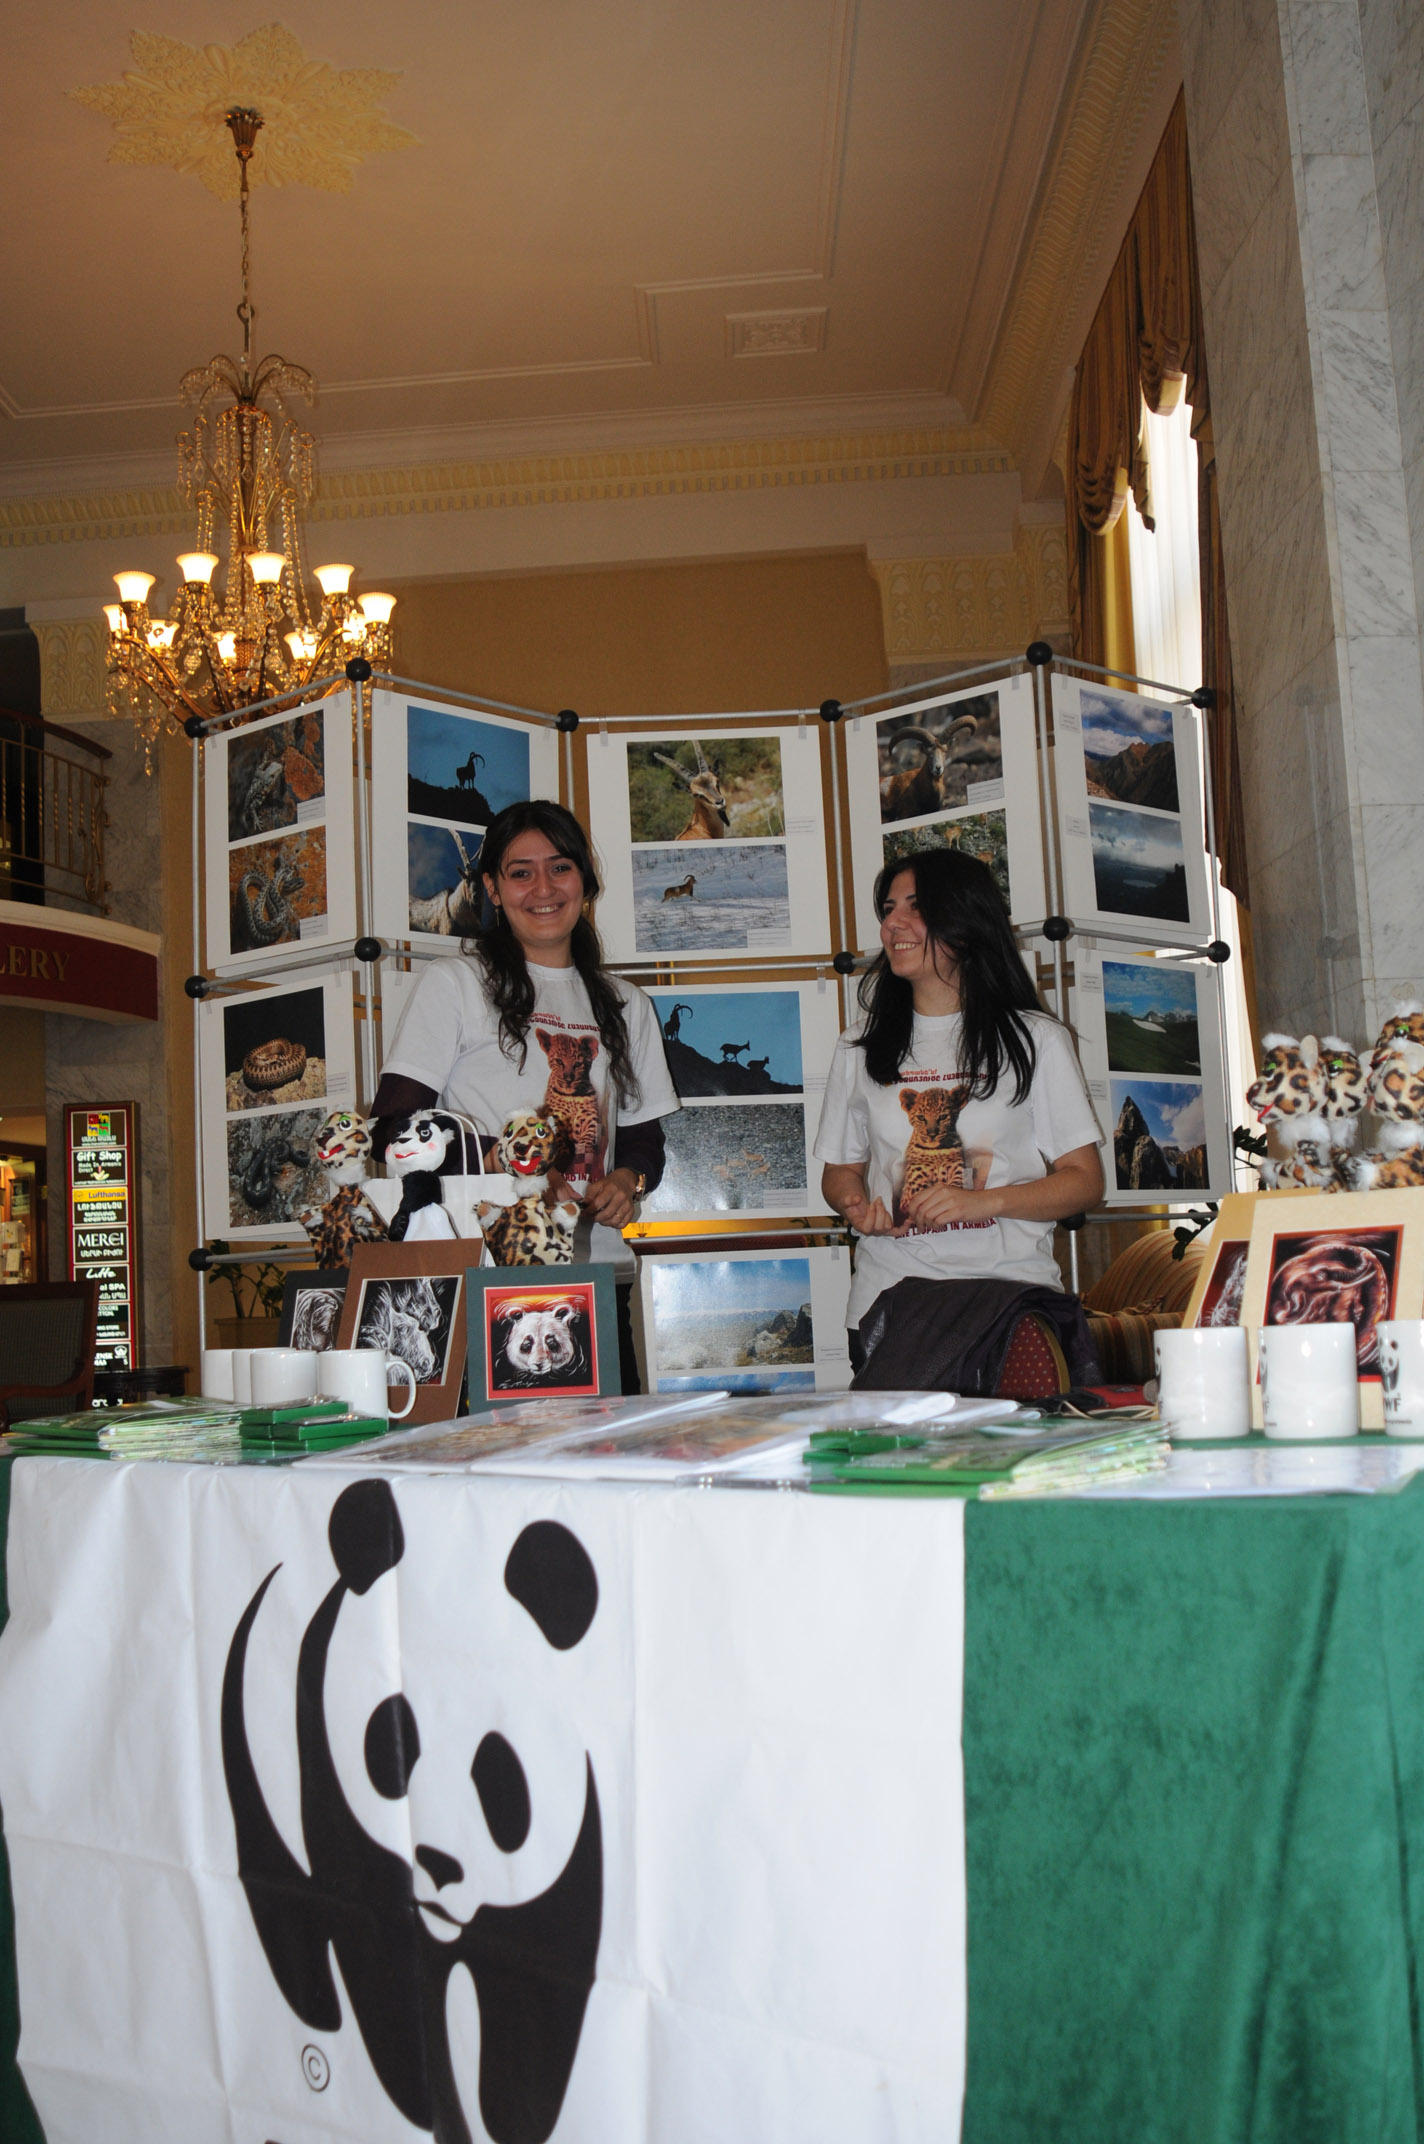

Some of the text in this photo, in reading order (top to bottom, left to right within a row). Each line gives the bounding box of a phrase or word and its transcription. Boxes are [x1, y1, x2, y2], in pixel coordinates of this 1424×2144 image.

[77, 1150, 122, 1162] Gift Shop
[88, 1191, 125, 1199] Lufthansa
[78, 1232, 124, 1247] MERCI
[108, 1283, 126, 1291] SPA
